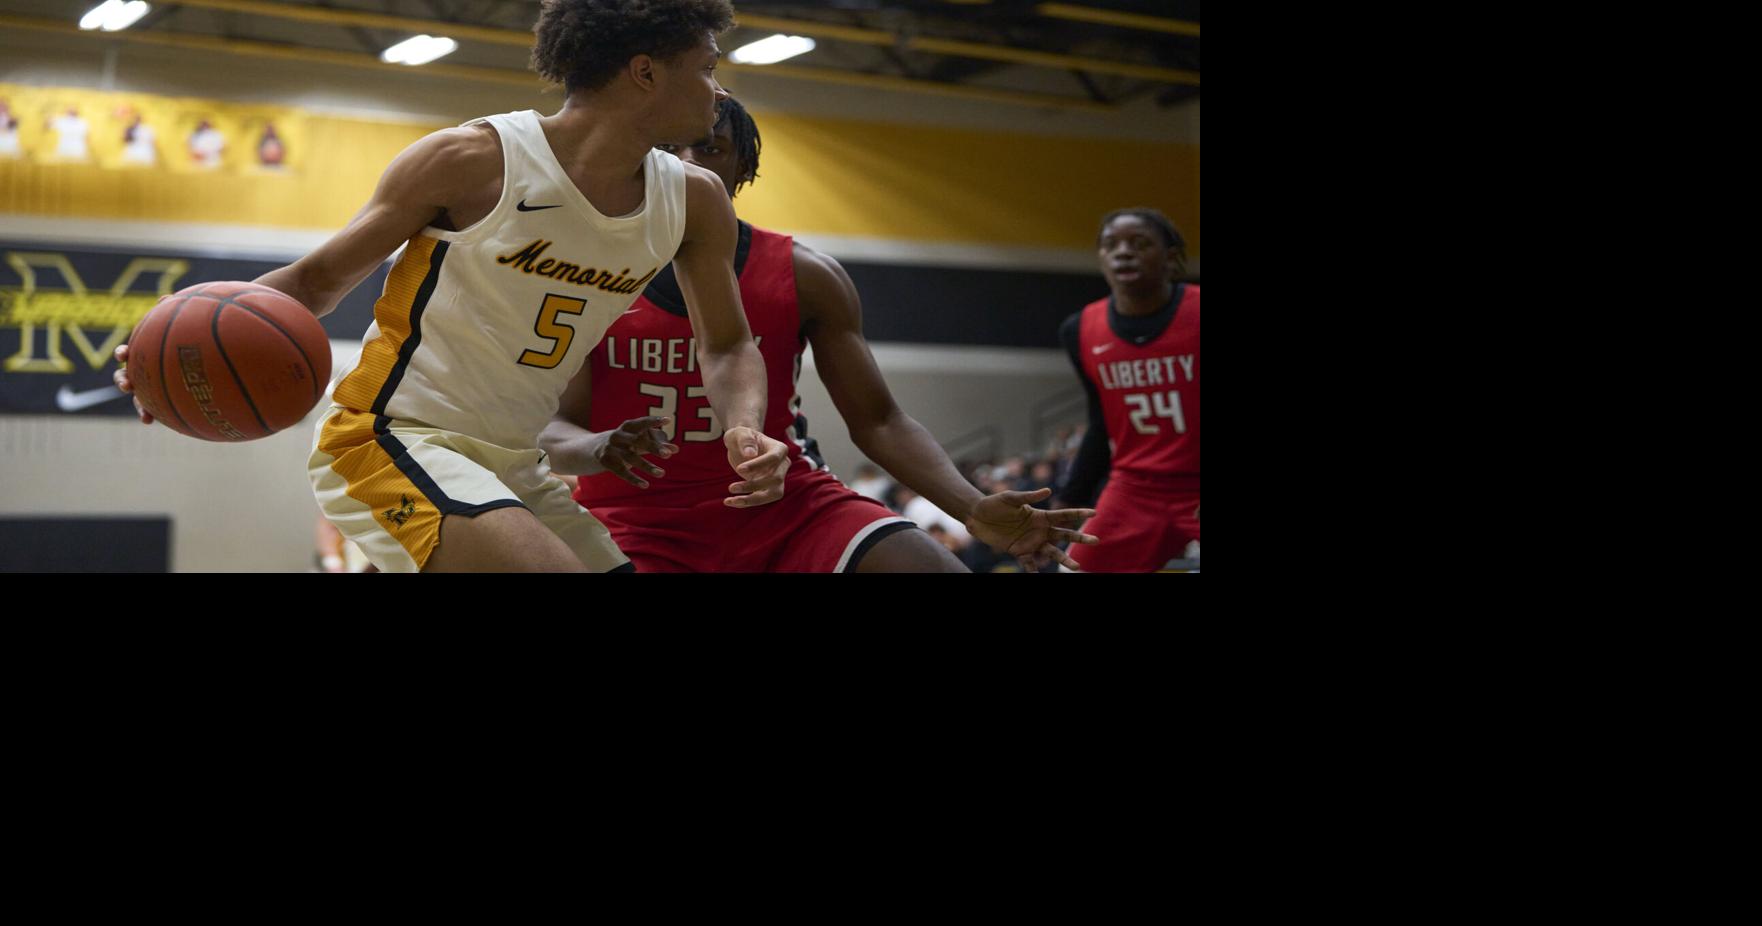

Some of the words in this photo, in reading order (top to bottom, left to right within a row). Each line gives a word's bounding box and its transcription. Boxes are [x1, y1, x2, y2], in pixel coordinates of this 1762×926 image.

[496, 239, 657, 294] Memorial
[516, 293, 587, 370] 5
[607, 336, 762, 374] LIBE
[1098, 353, 1194, 390] LIBERTY
[639, 382, 724, 443] 33
[1124, 390, 1186, 434] 24
